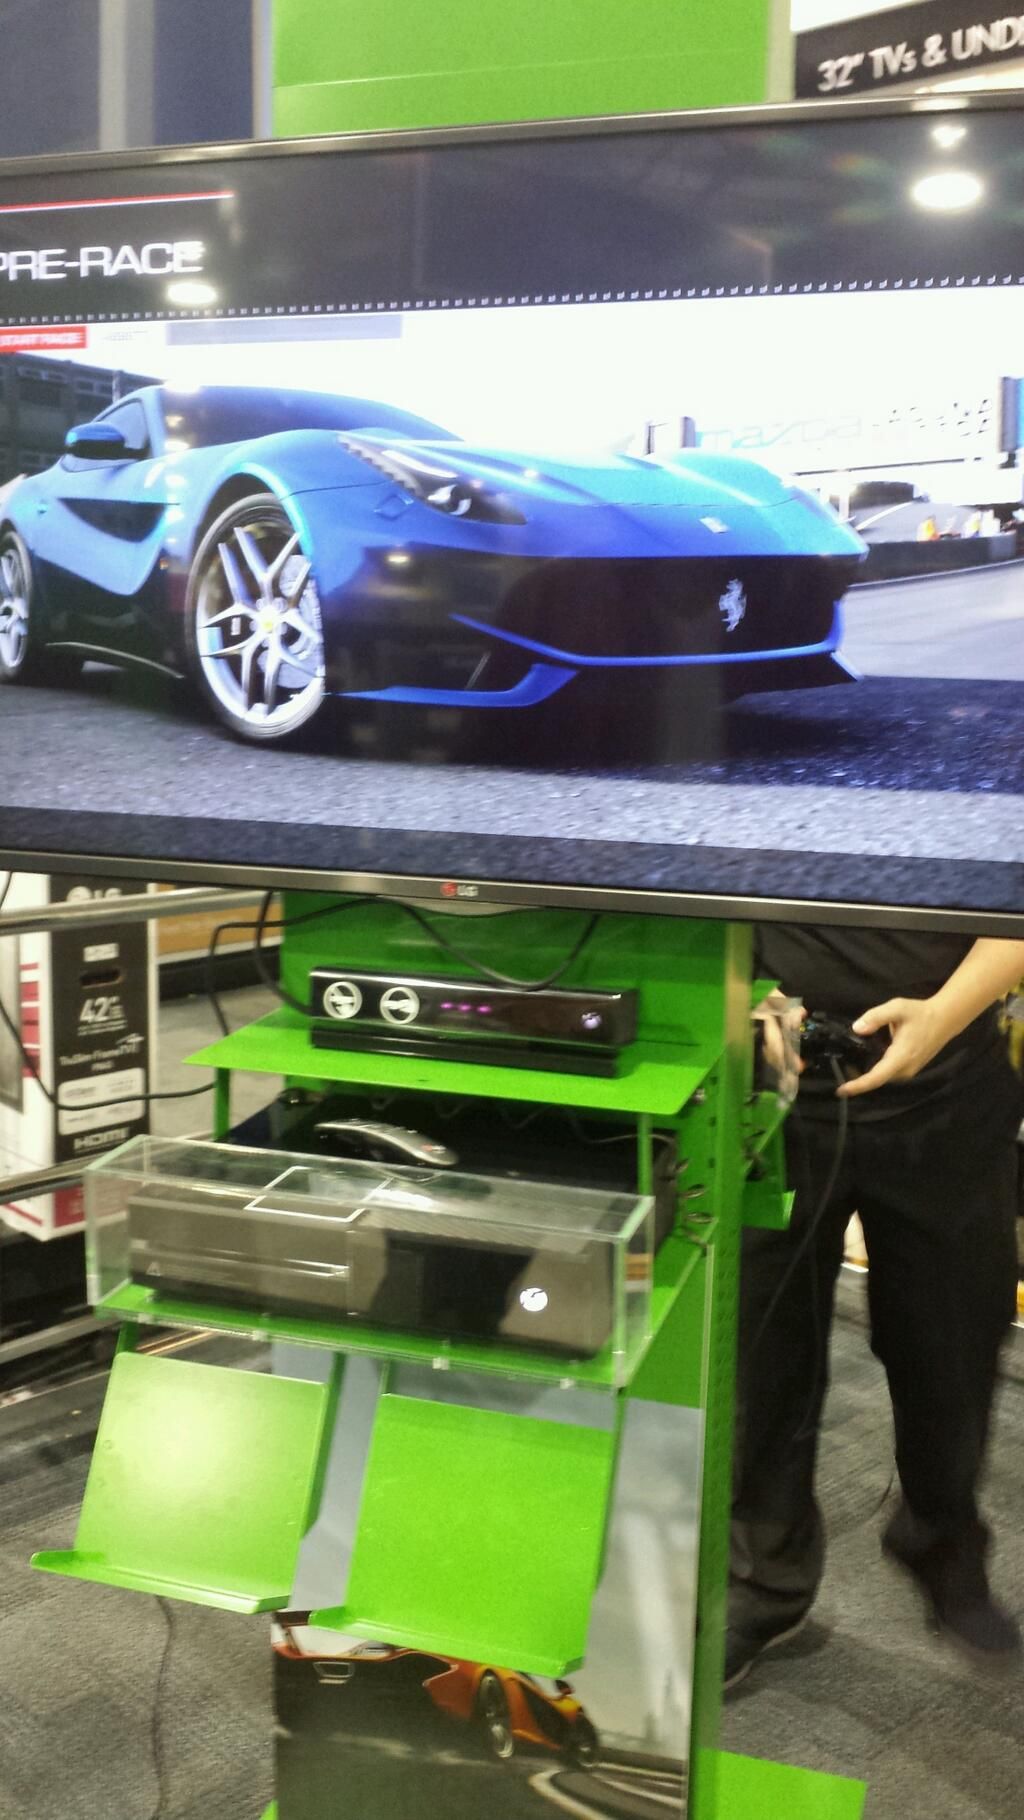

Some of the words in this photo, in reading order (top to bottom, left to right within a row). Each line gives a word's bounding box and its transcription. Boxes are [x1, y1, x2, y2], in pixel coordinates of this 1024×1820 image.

[868, 42, 917, 79] TVs
[921, 33, 947, 68] &
[951, 15, 1024, 61] UND
[74, 1127, 129, 1149] HDMI
